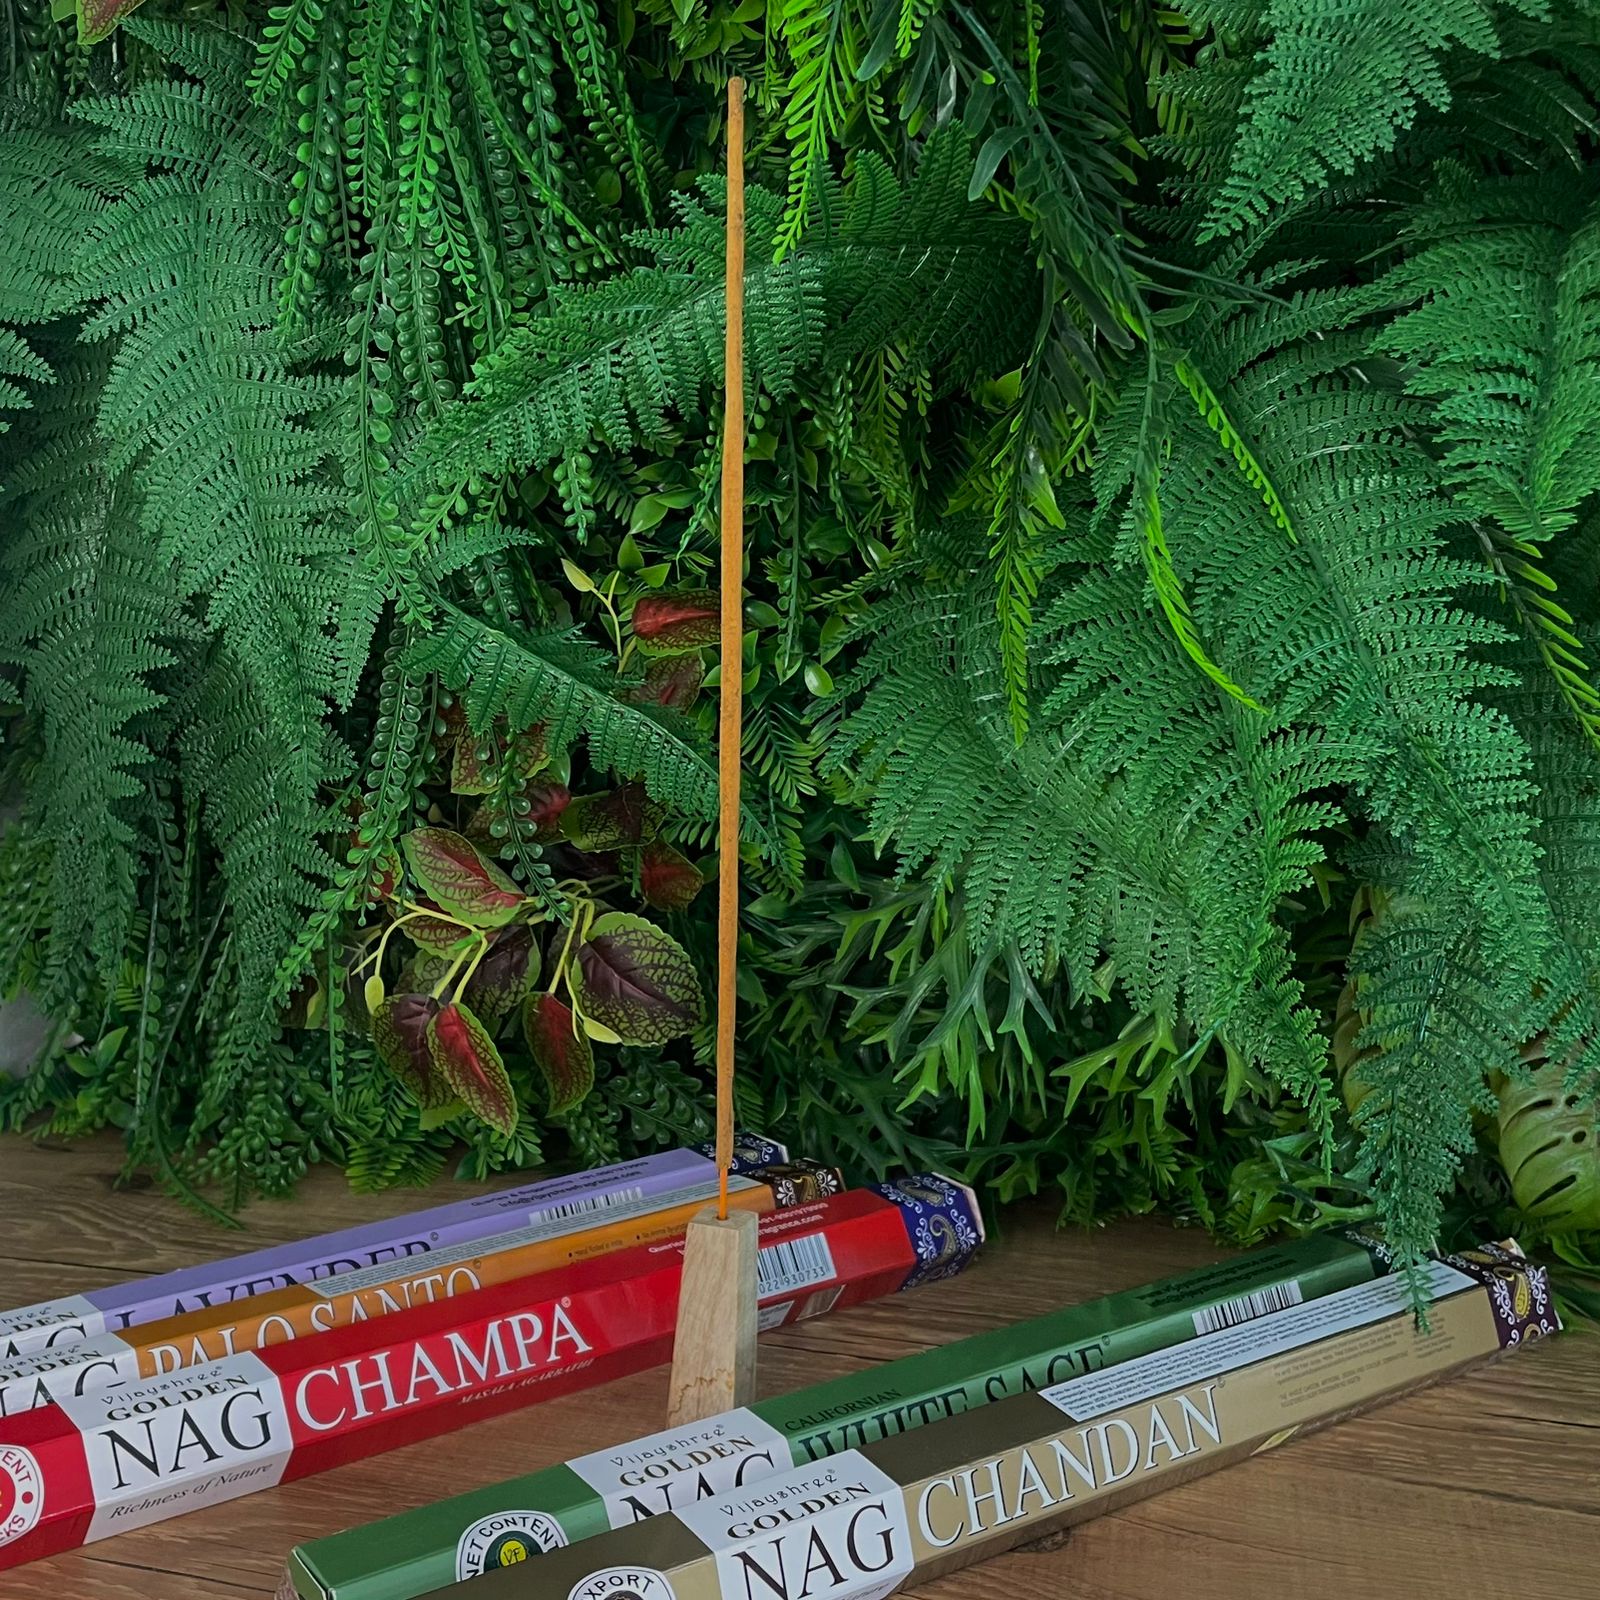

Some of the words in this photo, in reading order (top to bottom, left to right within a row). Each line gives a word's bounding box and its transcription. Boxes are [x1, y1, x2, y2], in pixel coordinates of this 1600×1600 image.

[0, 1311, 78, 1337] DEN
[0, 1358, 127, 1417] AG
[101, 1369, 219, 1405] Vijayshree
[295, 1303, 593, 1431] CHAMPA
[106, 1374, 250, 1422] GOLDEN
[785, 1388, 902, 1433] CALIFORNIAN
[98, 1388, 272, 1491] NAG
[610, 1428, 723, 1468] Vijayshree
[619, 1435, 756, 1487] GOLDEN
[0, 1450, 32, 1482] ENT
[918, 1385, 1221, 1548] CHANDAN
[109, 1488, 188, 1520] Richness
[193, 1478, 214, 1496] of
[215, 1463, 273, 1488] Nature
[720, 1473, 837, 1517] Vijayshree
[727, 1482, 872, 1539] GOLDEN
[0, 1514, 25, 1541] KS
[732, 1500, 895, 1600] NAG
[580, 1574, 655, 1600] XPORT
